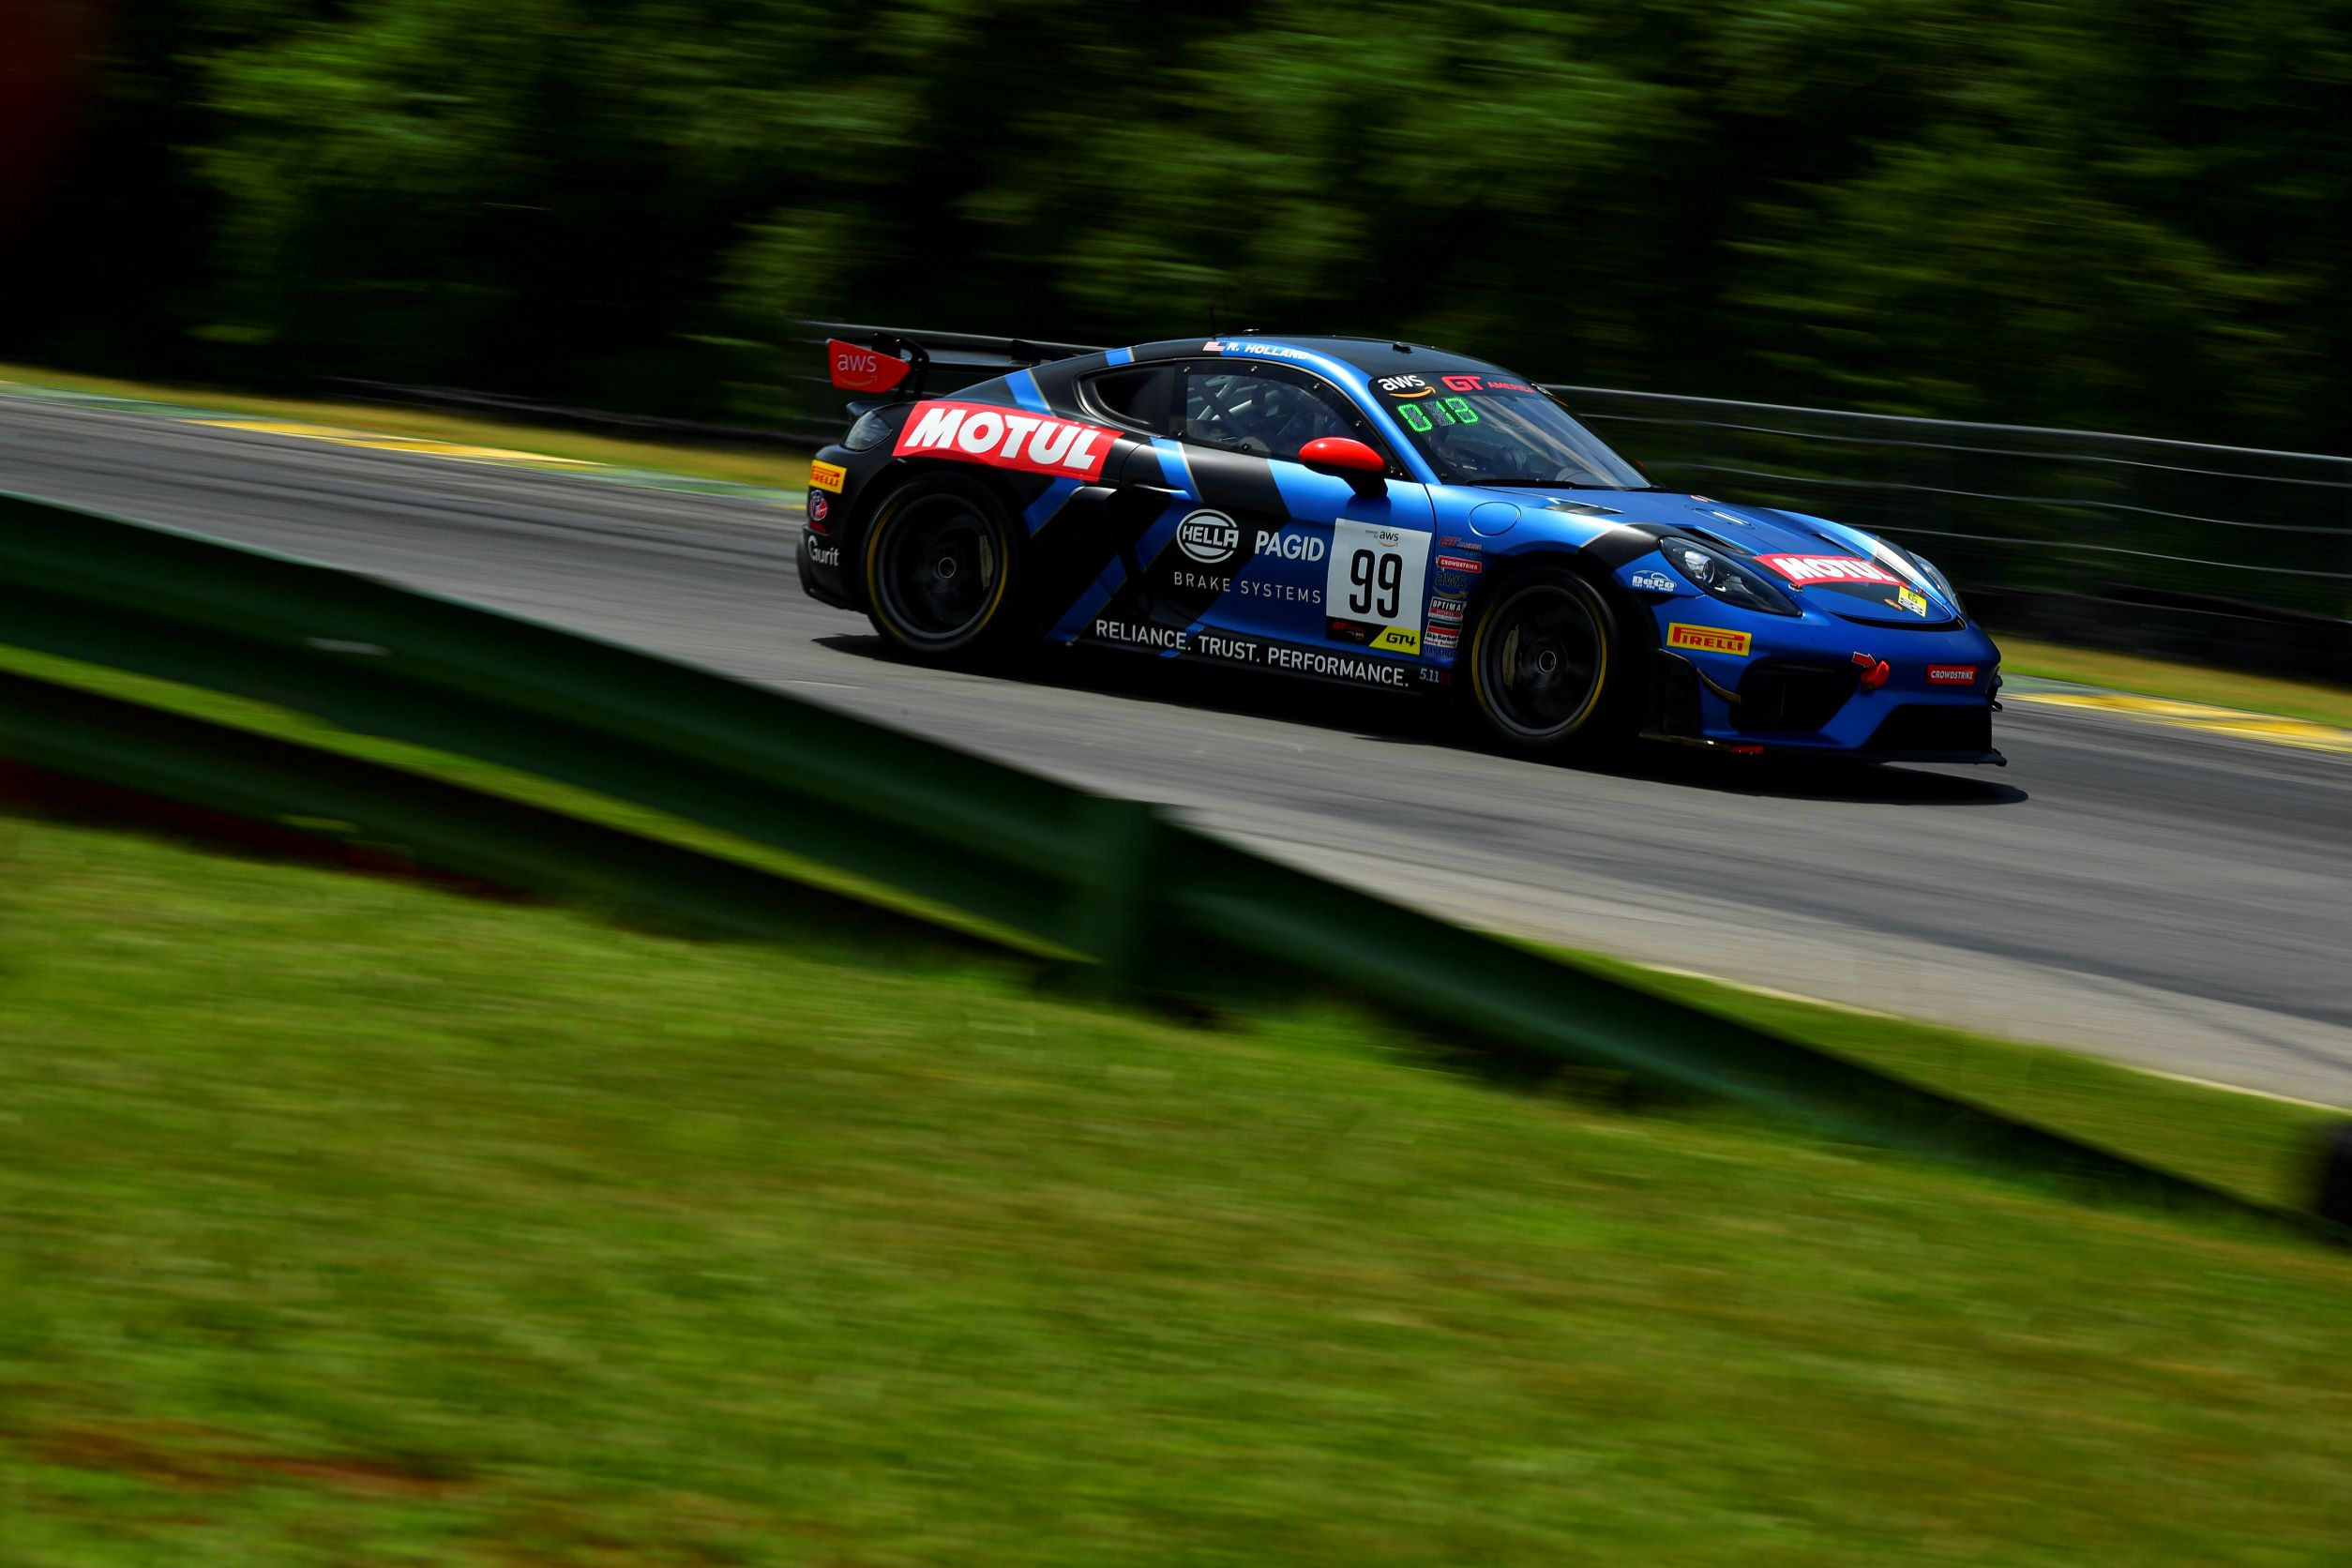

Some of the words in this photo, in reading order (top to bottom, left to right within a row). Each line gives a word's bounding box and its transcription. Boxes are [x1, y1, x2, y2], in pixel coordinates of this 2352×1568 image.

[1226, 342, 1240, 352] R.
[1244, 344, 1307, 360] HOLLAND
[837, 352, 877, 373] aws
[1378, 374, 1426, 392] aws
[1441, 375, 1485, 392] GT
[1486, 381, 1537, 394] AMERICA
[904, 408, 1103, 470] MOTUL
[1182, 525, 1240, 549] HELLA
[1255, 530, 1325, 562] PAGID
[1379, 531, 1399, 542] aws
[807, 535, 840, 566] Gurit
[1435, 571, 1468, 589] aws
[1772, 557, 1900, 584] MOTUL
[1174, 571, 1231, 593] BRAKE
[1240, 580, 1321, 604] SYSTEMS
[1349, 549, 1403, 619] 99
[1432, 600, 1461, 611] OPTIMA
[1385, 632, 1416, 647] GT4
[1672, 626, 1745, 652] PIRELLI
[1095, 619, 1192, 651] RELIANCE.
[1198, 635, 1260, 663] TRUST.
[1268, 646, 1409, 686] PERFORMANCE.
[1419, 667, 1440, 684] 5.11
[1930, 670, 1974, 680] CROWDSTRIKE
